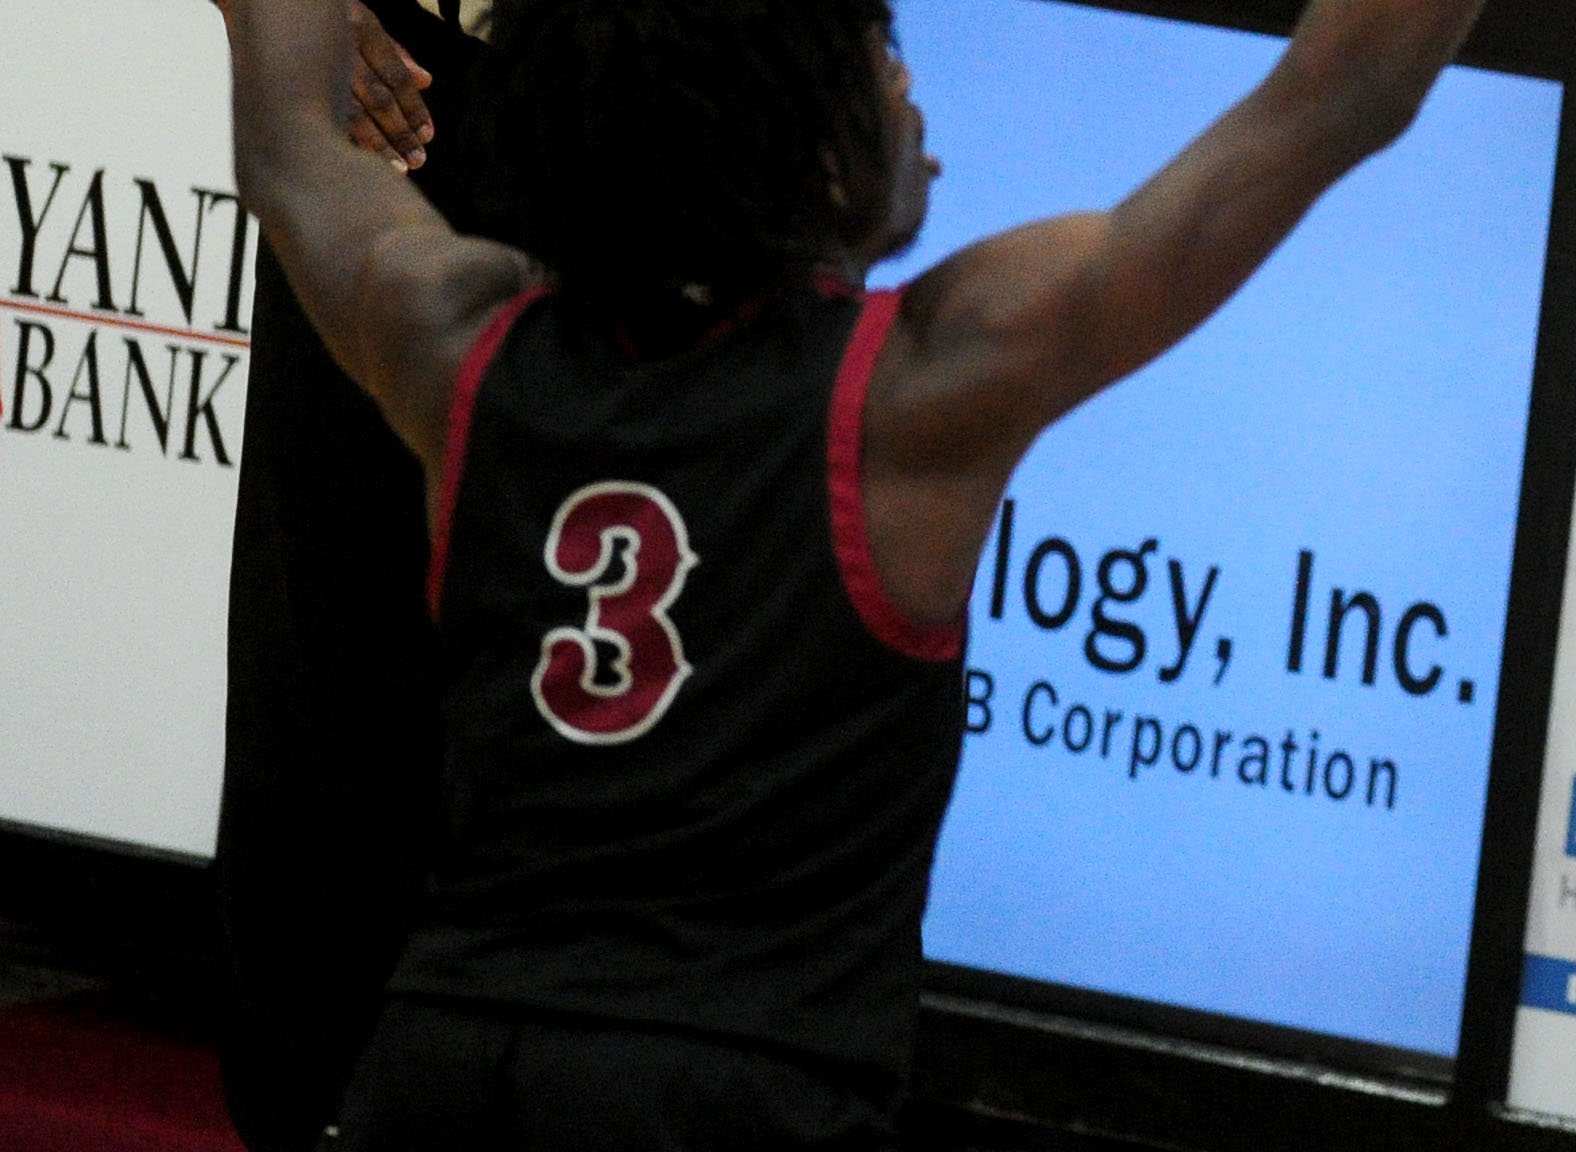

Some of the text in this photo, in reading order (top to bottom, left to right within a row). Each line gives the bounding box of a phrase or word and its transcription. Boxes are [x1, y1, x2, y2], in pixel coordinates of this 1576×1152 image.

[2, 154, 251, 334] YANT
[6, 316, 240, 468] BANK
[530, 480, 700, 746] 3
[989, 498, 1476, 705] logy, Inc.
[1021, 680, 1398, 811] Corporation
